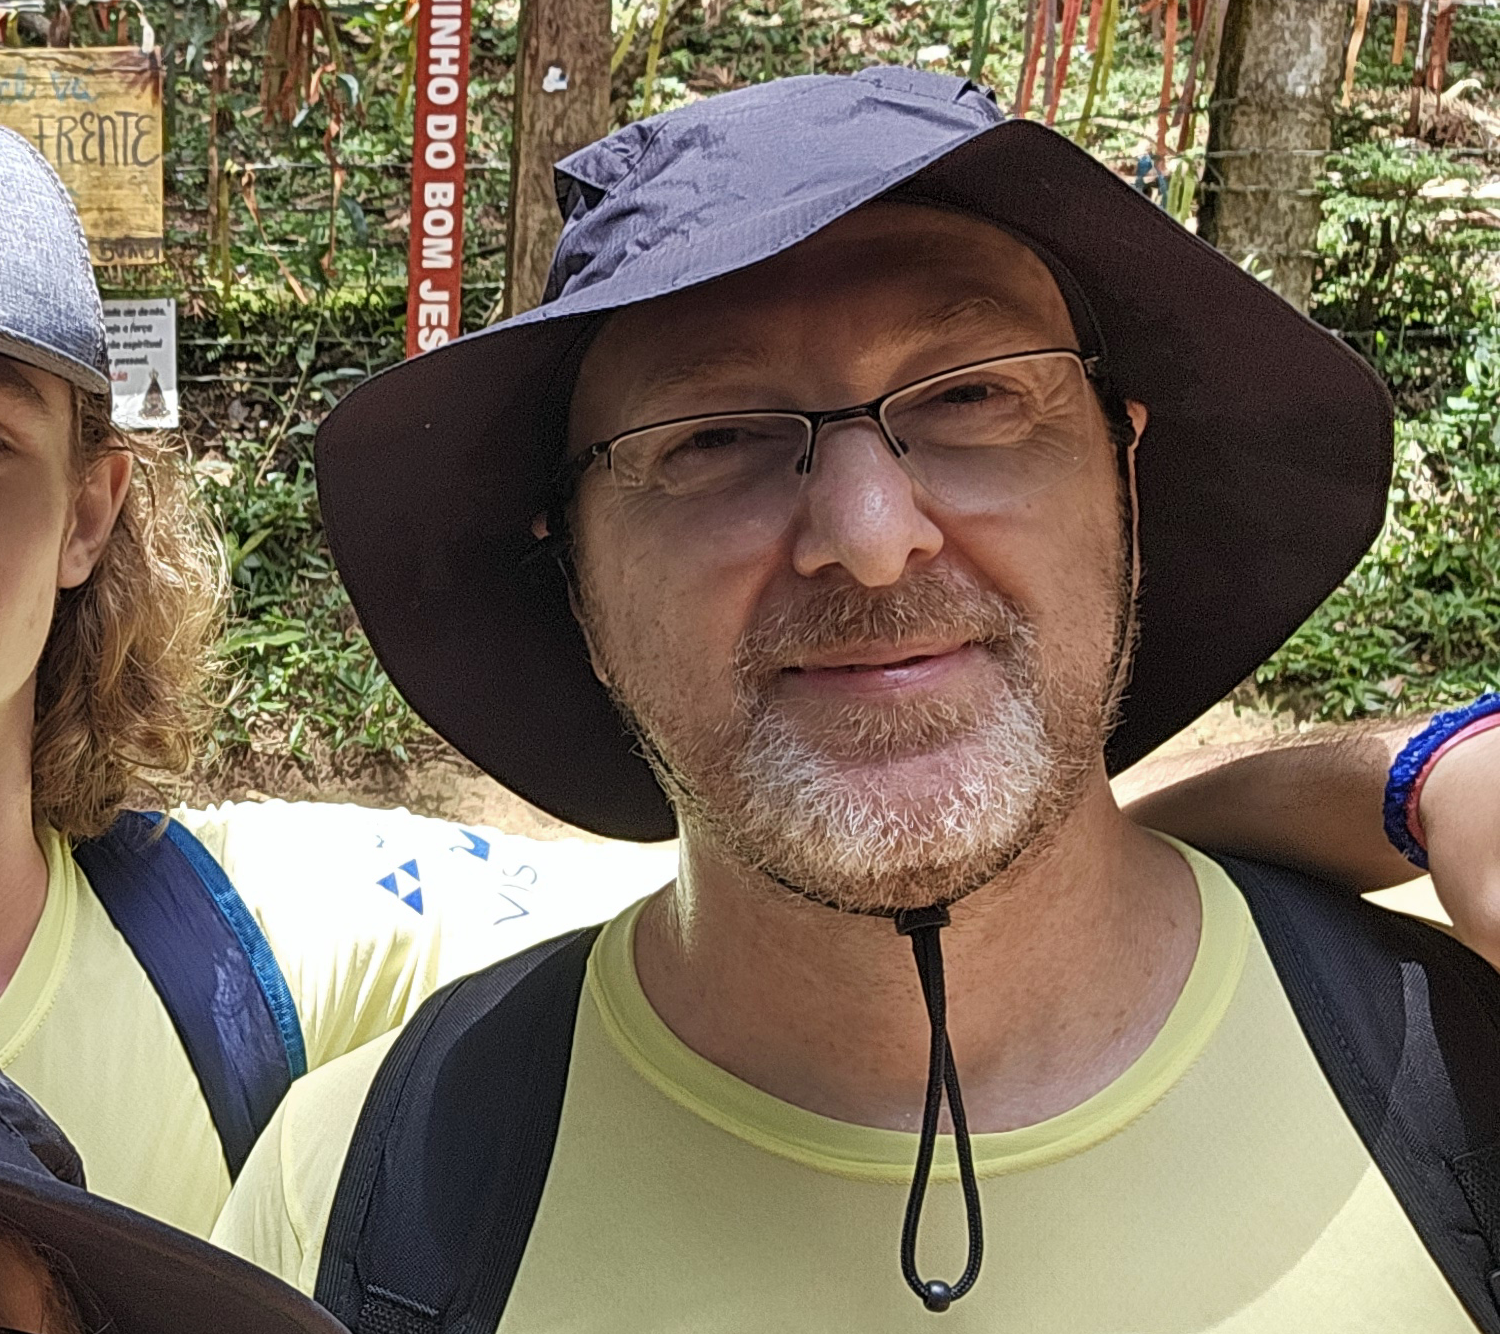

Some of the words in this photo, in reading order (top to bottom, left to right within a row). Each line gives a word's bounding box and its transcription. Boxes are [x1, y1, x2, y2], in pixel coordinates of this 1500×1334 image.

[32, 110, 160, 168] FRENTE
[423, 114, 458, 170] DO
[420, 182, 456, 269] BOM
